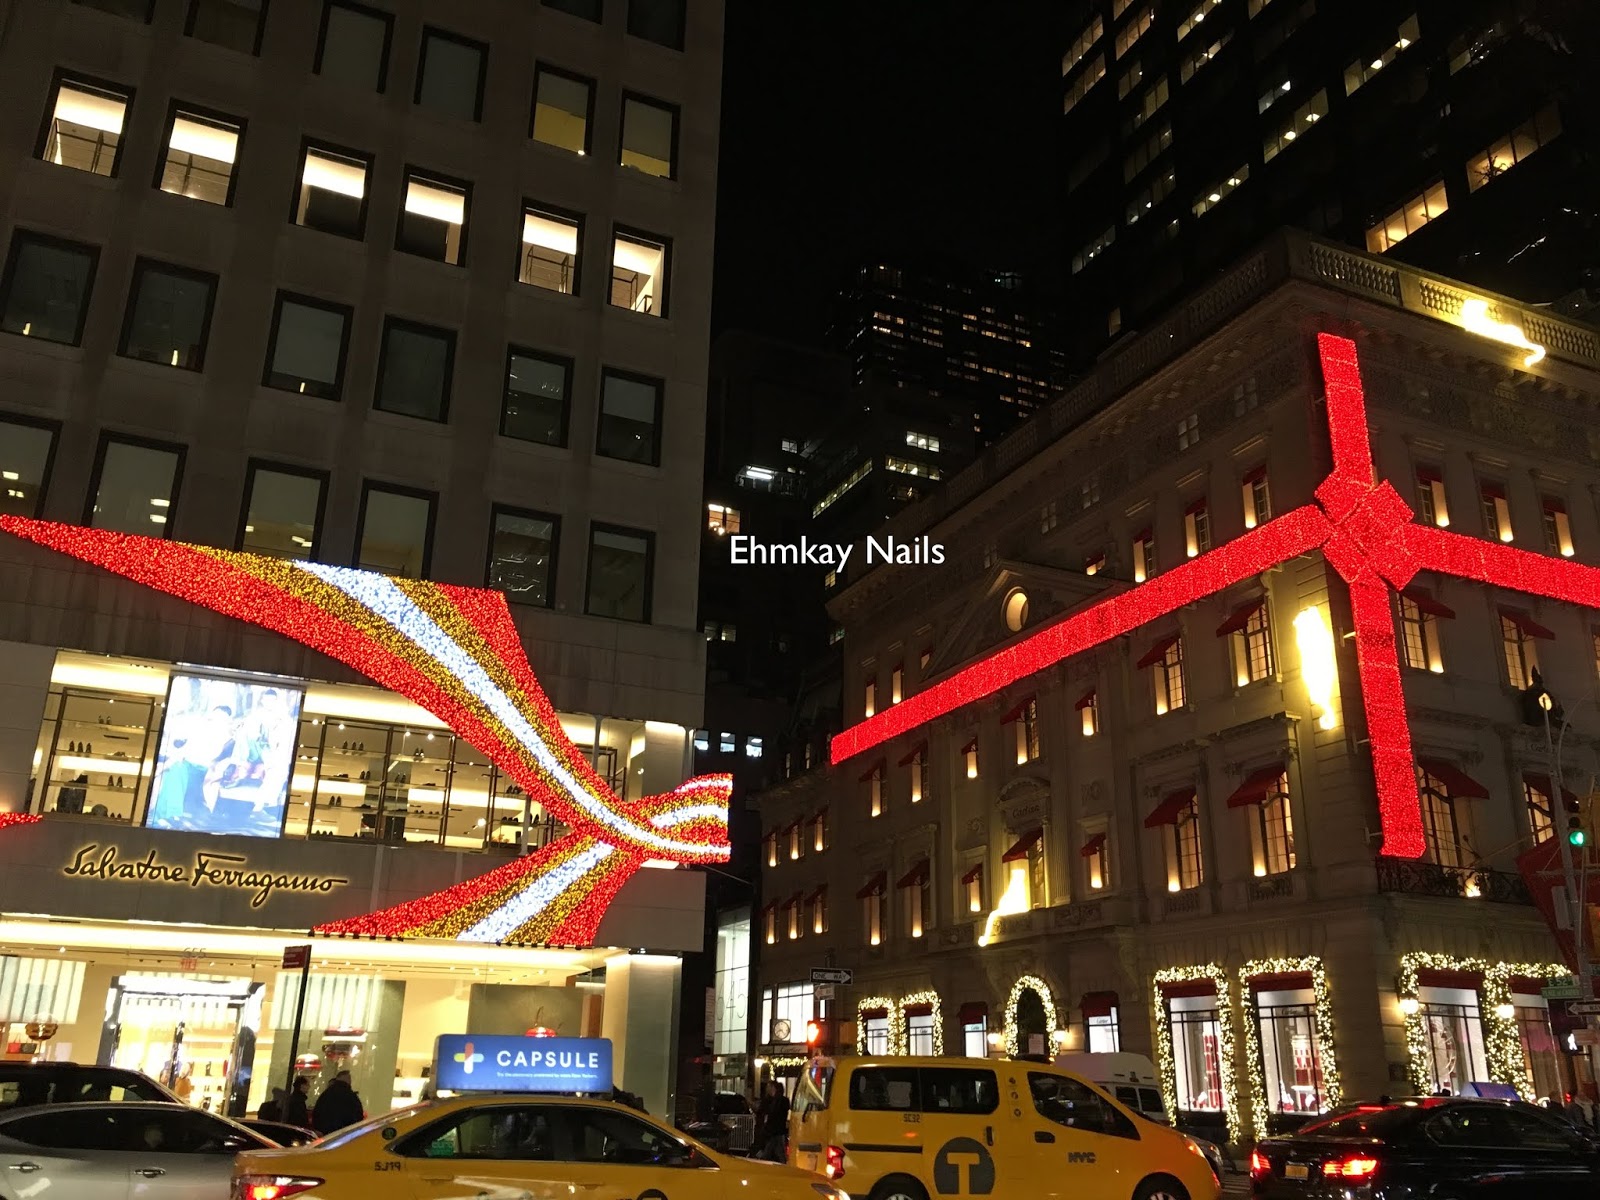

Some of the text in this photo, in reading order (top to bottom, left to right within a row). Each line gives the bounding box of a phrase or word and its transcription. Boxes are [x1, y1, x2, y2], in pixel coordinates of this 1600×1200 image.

[64, 844, 348, 907] Salvatore Ferragamo
[813, 972, 827, 980] ONE
[496, 1050, 599, 1069] CAPSULE
[1068, 1152, 1097, 1164] NYC
